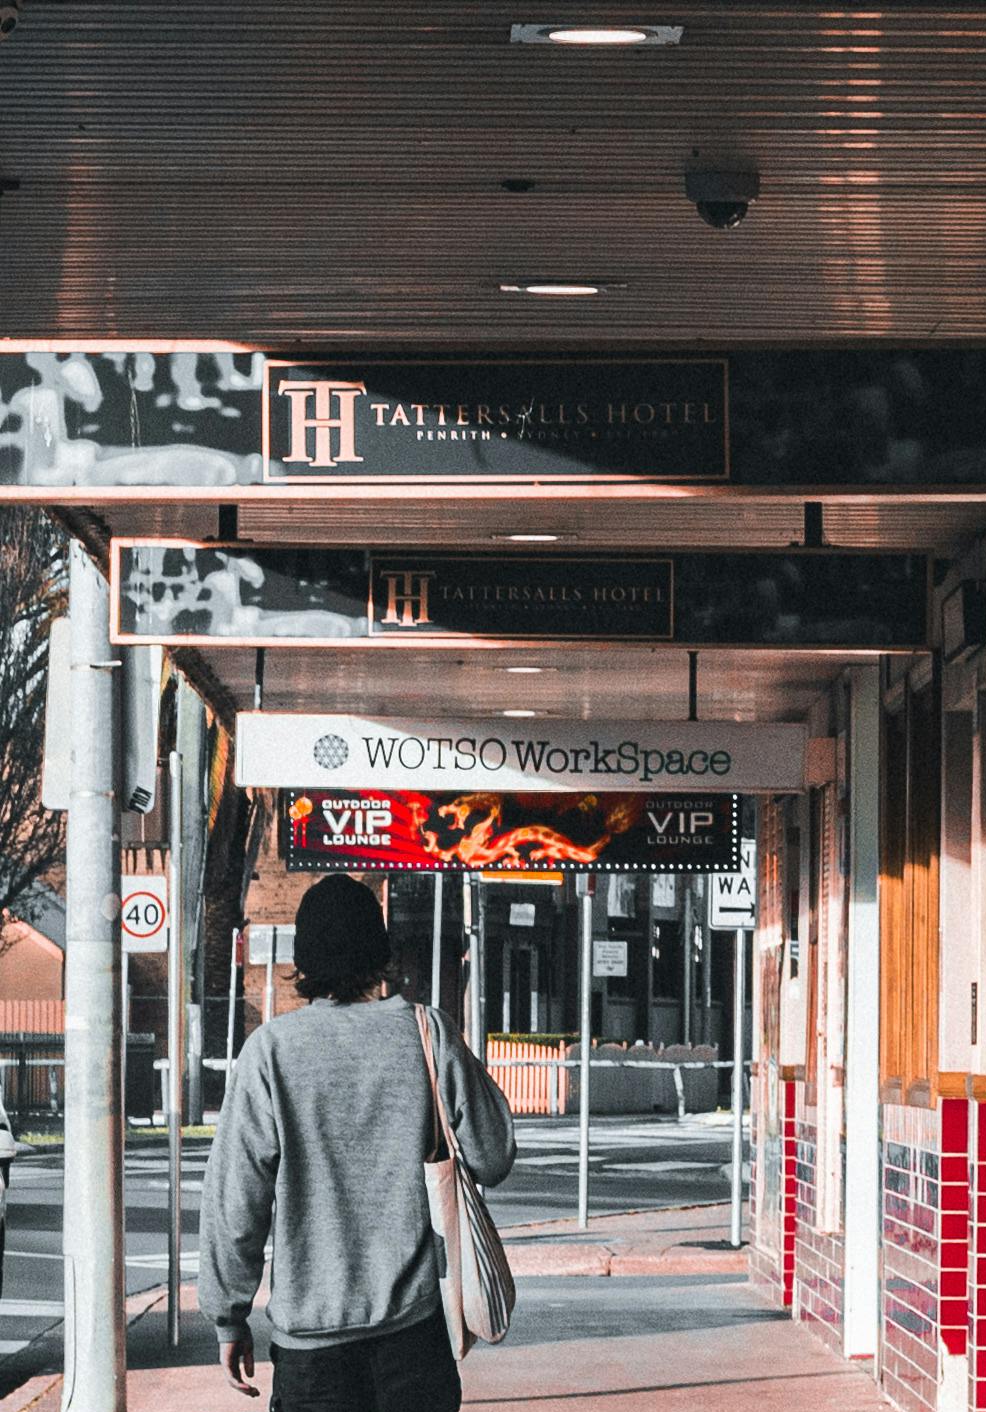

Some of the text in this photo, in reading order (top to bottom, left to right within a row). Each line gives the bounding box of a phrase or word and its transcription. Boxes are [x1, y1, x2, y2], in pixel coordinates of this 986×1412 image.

[370, 402, 717, 425] TATTERSALLS HOTEL
[416, 430, 491, 441] PENRITH
[439, 586, 664, 602] TATTERSALLS HOTEL
[362, 737, 732, 781] WOTSO WorkSpace
[322, 800, 391, 810] OUTDOOR
[645, 801, 713, 809] OUTDOOR
[323, 811, 392, 835] VIP
[647, 811, 714, 834] VIP
[323, 835, 391, 846] LOUNGE
[647, 835, 714, 845] LOUNGE
[719, 876, 751, 895] WA
[126, 903, 159, 925] 40
